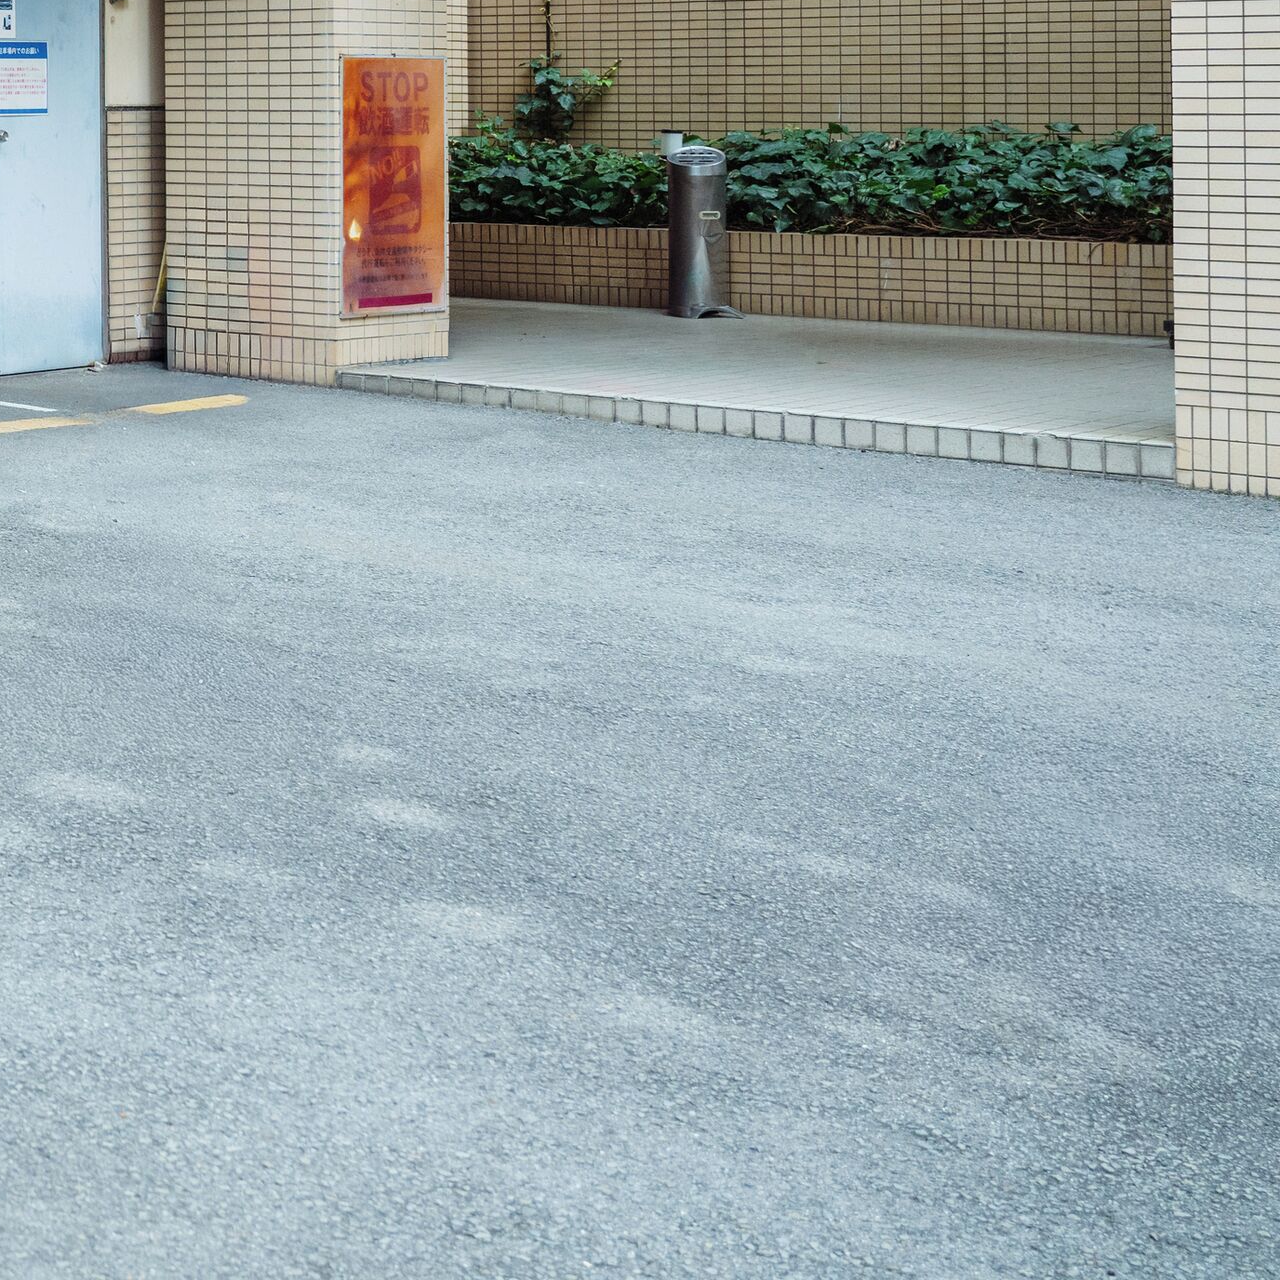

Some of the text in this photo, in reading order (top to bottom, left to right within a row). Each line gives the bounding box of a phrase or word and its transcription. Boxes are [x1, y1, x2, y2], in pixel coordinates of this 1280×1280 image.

[359, 71, 430, 103] STOP
[357, 105, 430, 137] 飲酒運転
